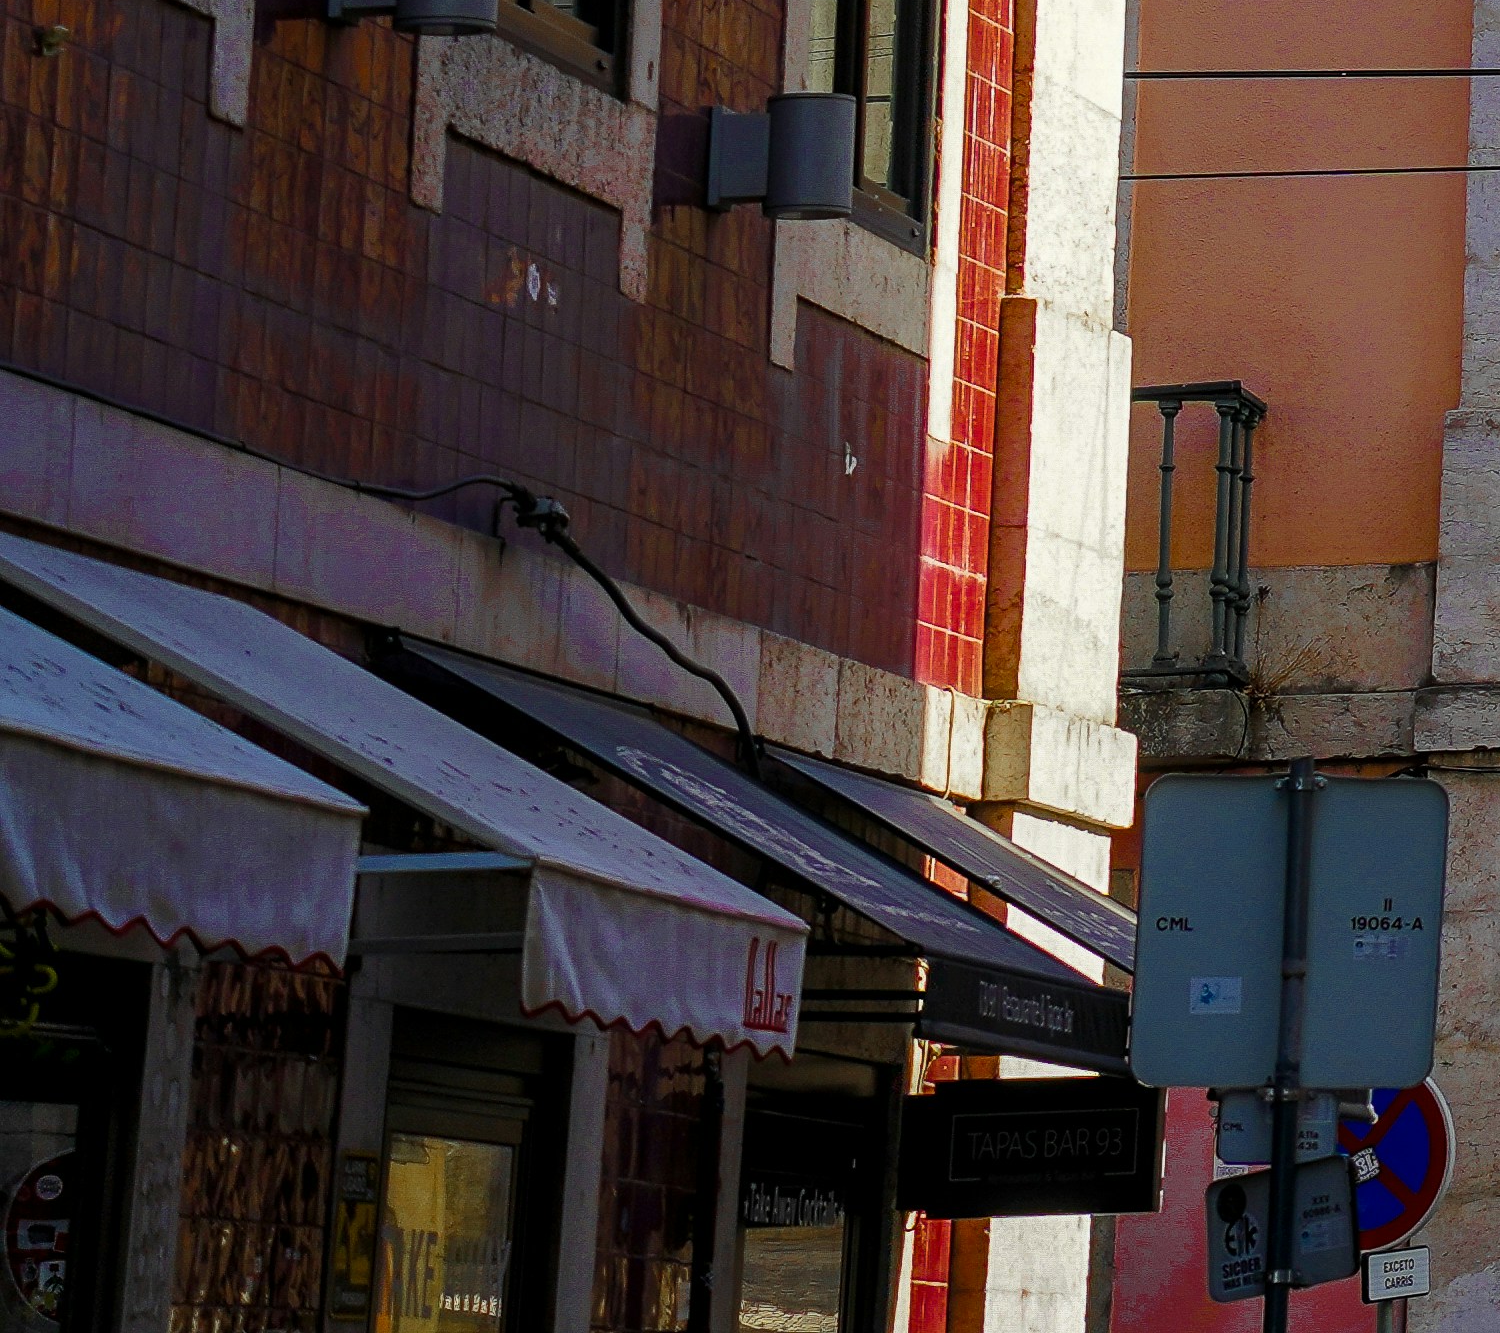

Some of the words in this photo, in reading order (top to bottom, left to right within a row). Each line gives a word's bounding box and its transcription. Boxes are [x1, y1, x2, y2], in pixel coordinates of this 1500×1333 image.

[1156, 916, 1194, 933] CML
[1350, 916, 1424, 932] 19064-A
[967, 1130, 1038, 1162] TAPAS
[1043, 1128, 1090, 1159] BAR
[1096, 1127, 1123, 1157] 93
[749, 1181, 771, 1224] Take
[772, 1185, 797, 1226] Away
[1383, 1258, 1415, 1274] EXCETO
[1384, 1274, 1414, 1290] CARRIS
